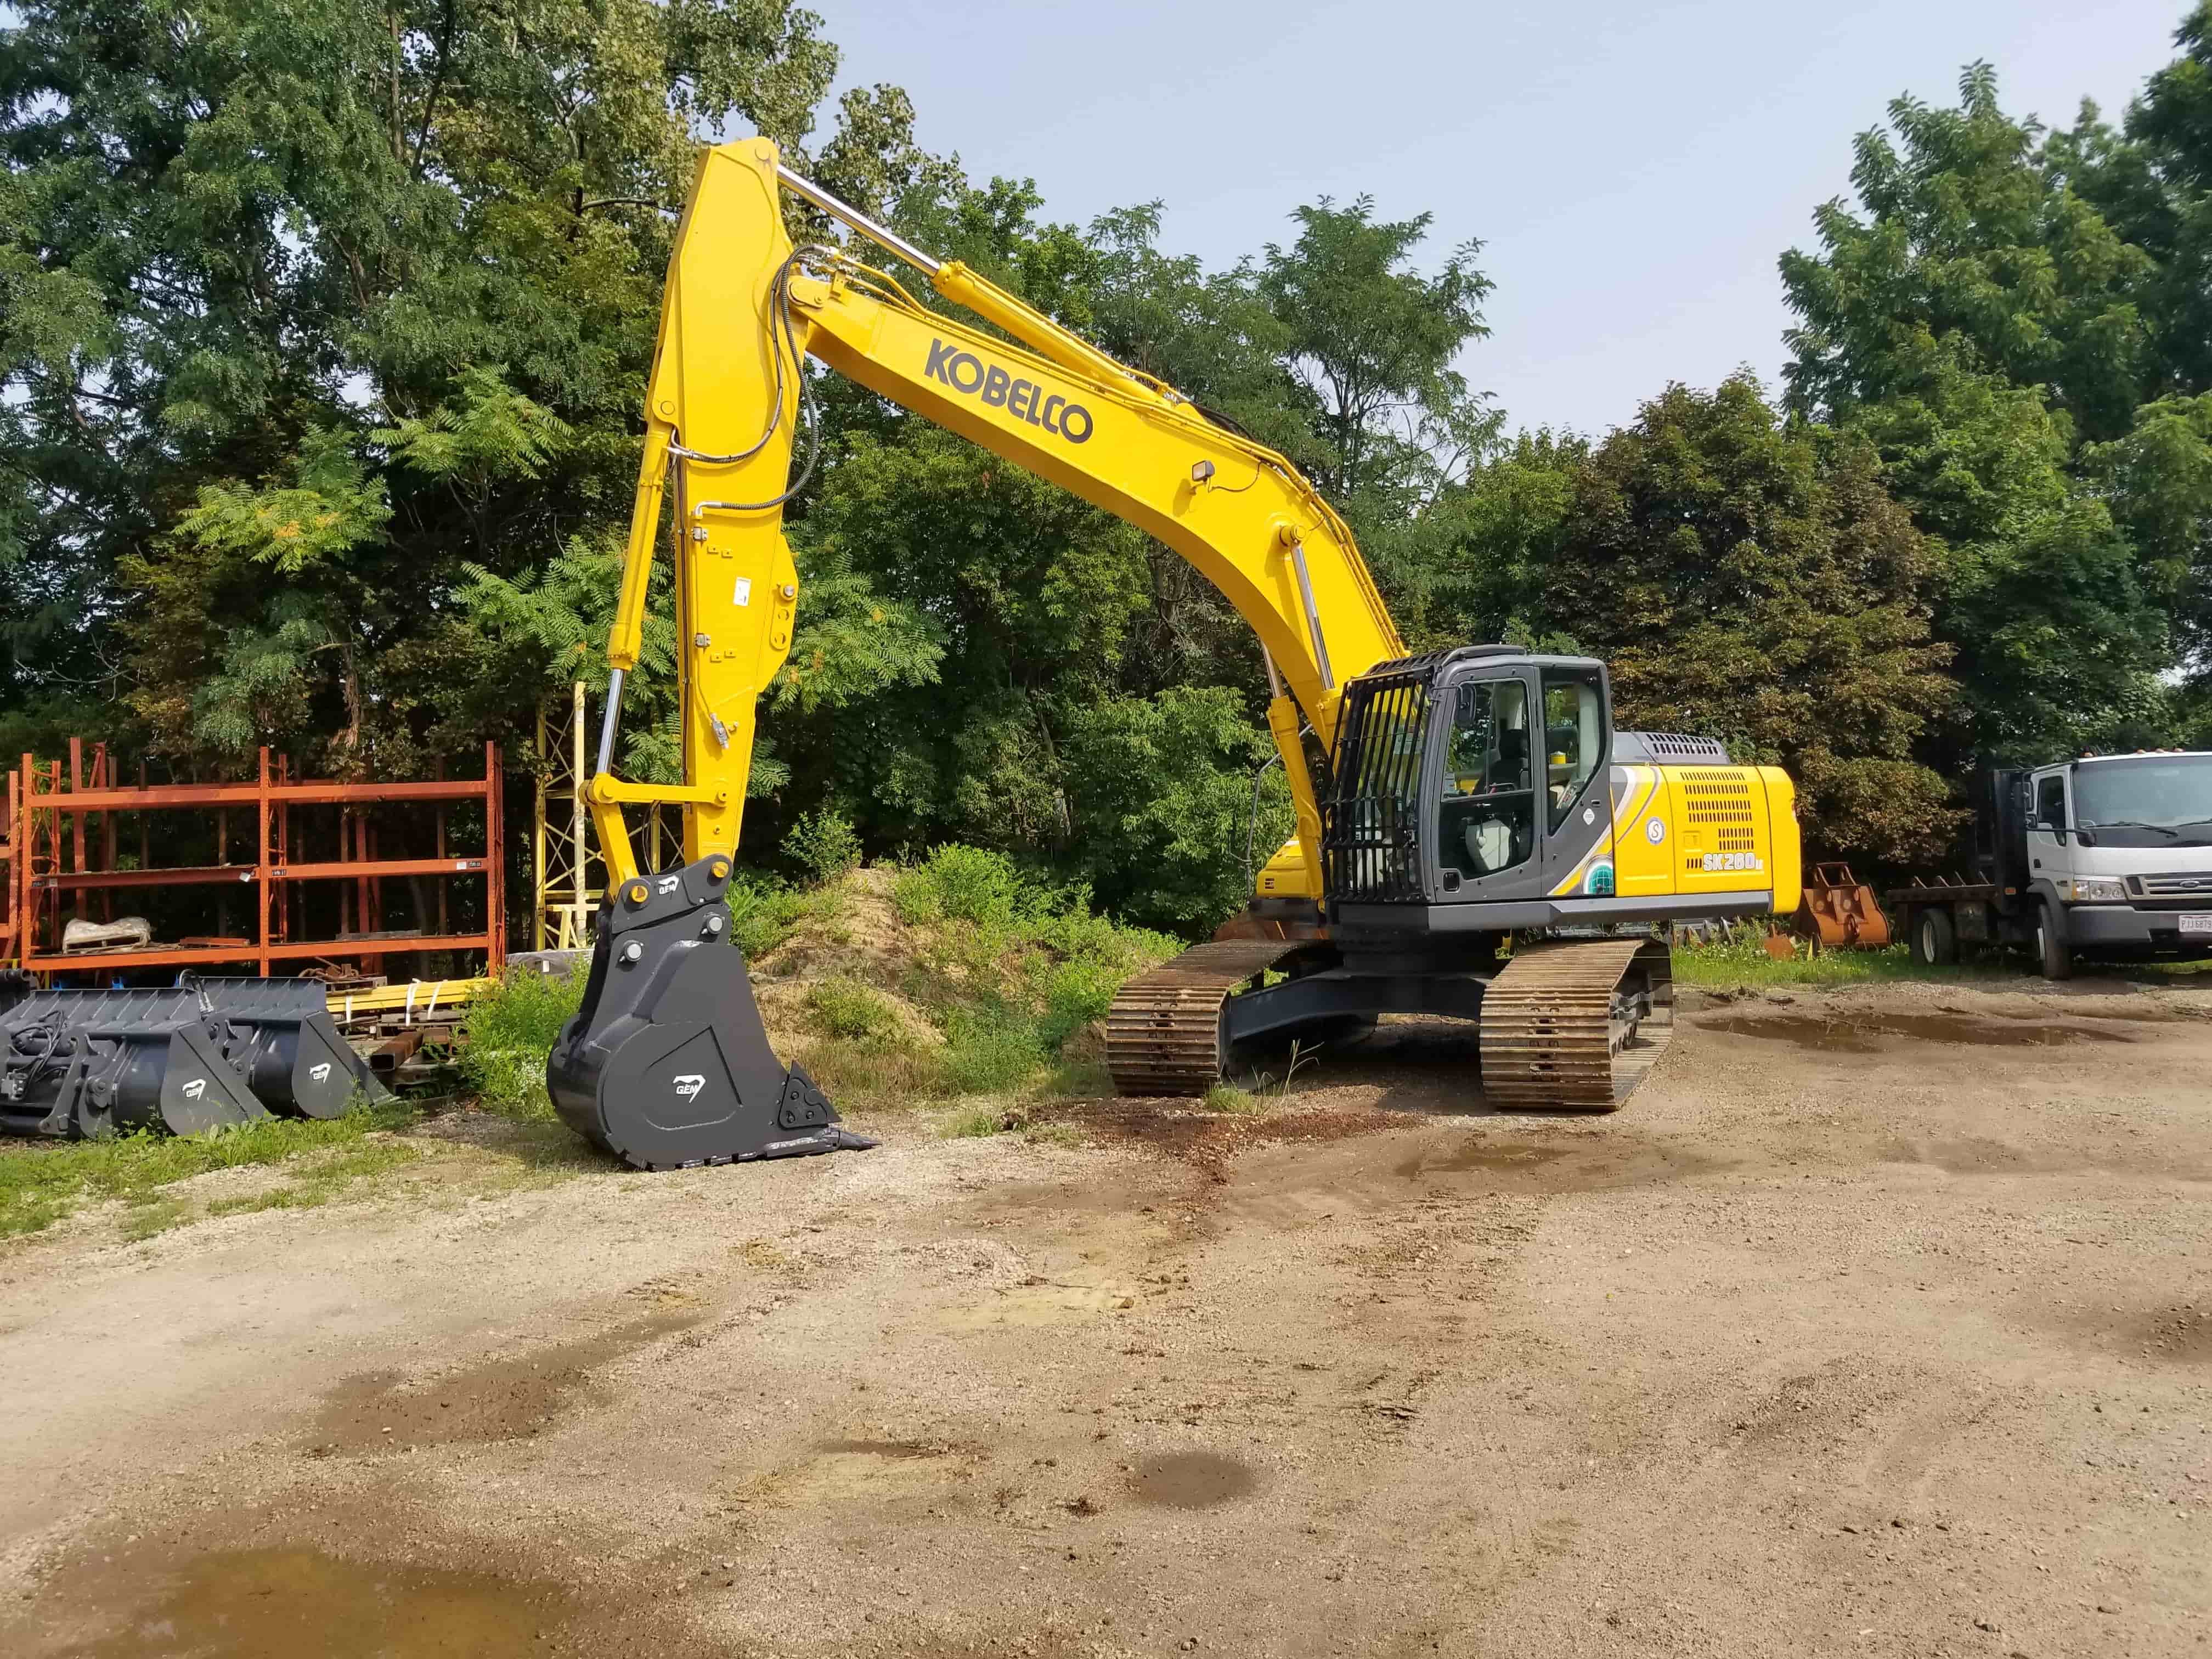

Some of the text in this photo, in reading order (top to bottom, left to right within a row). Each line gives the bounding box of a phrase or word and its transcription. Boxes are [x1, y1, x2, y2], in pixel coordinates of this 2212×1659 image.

[924, 338, 1093, 444] KOBELCO
[659, 883, 676, 894] GEM
[676, 1084, 699, 1094] GEM
